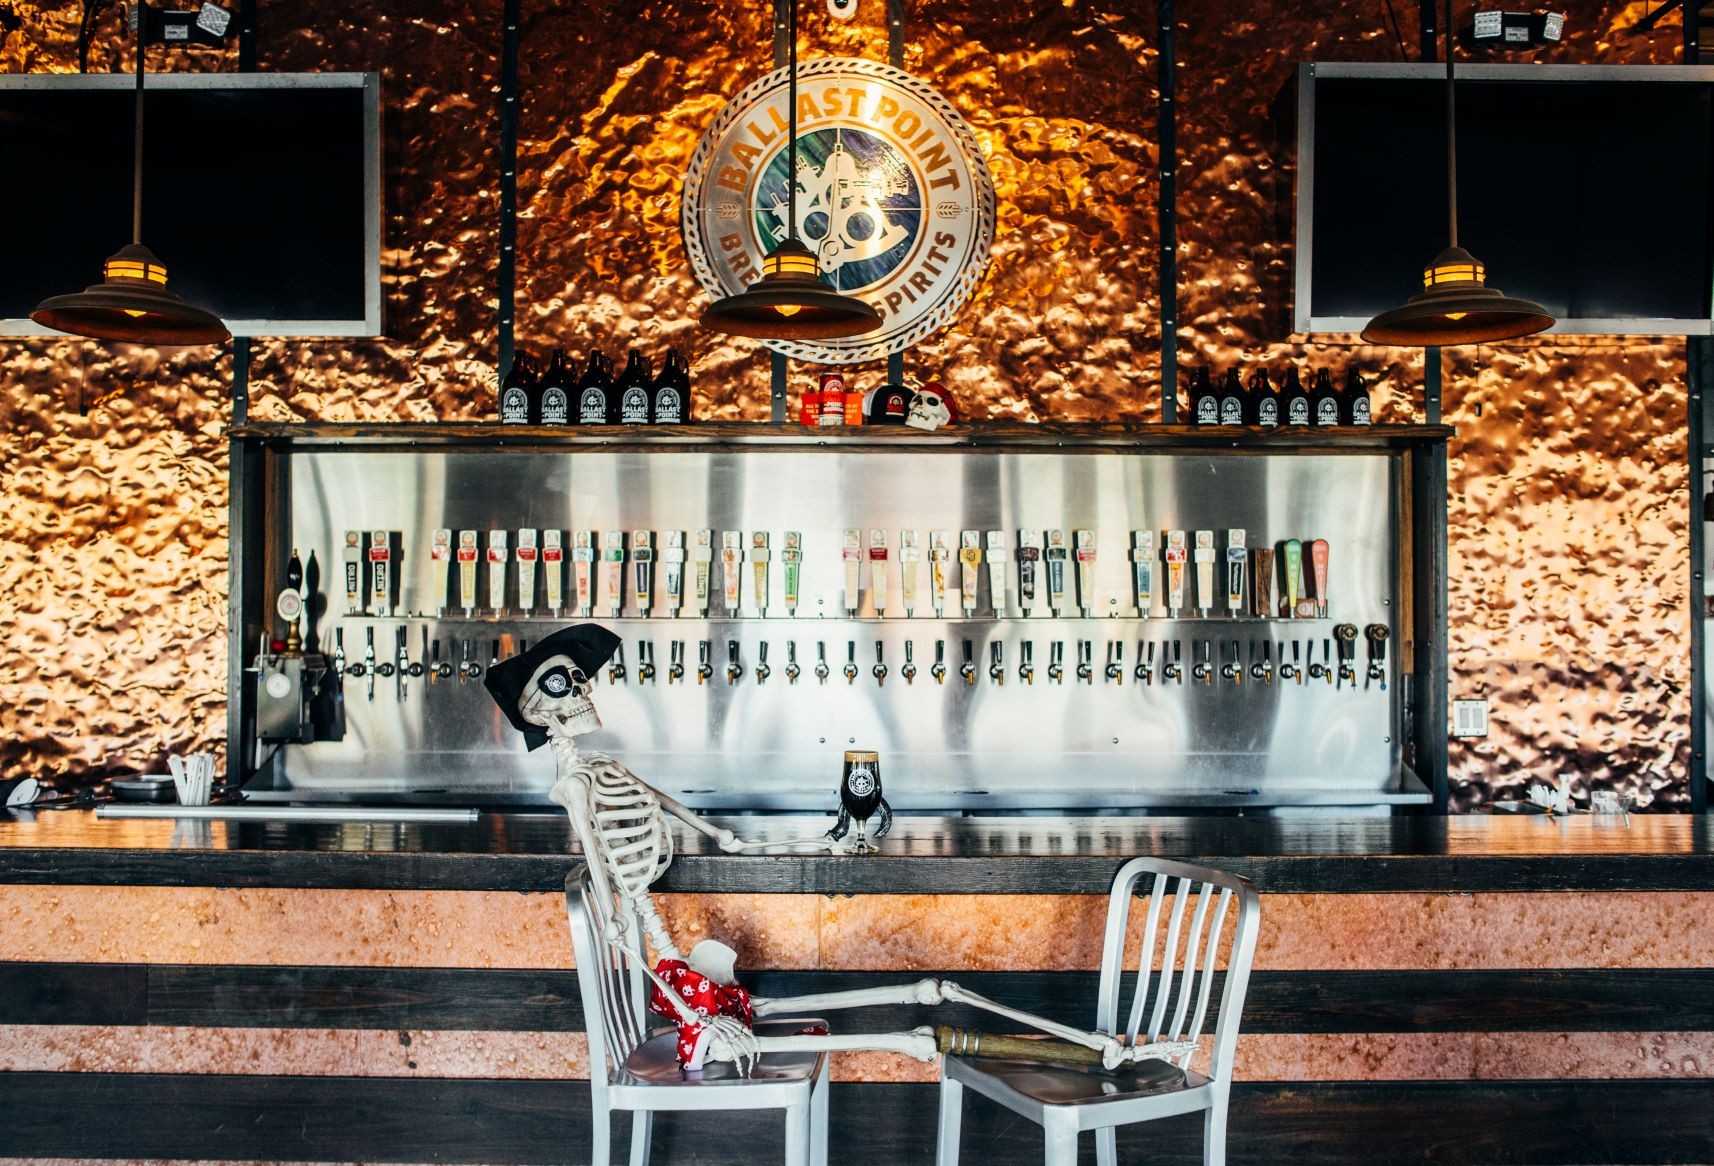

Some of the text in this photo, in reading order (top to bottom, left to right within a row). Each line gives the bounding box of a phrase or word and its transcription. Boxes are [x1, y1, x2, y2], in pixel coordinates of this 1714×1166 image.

[717, 88, 960, 193] BALLAST POINT
[720, 231, 957, 321] BRE SPIRITS
[348, 564, 356, 591] NITRO
[376, 564, 384, 590] NITRO
